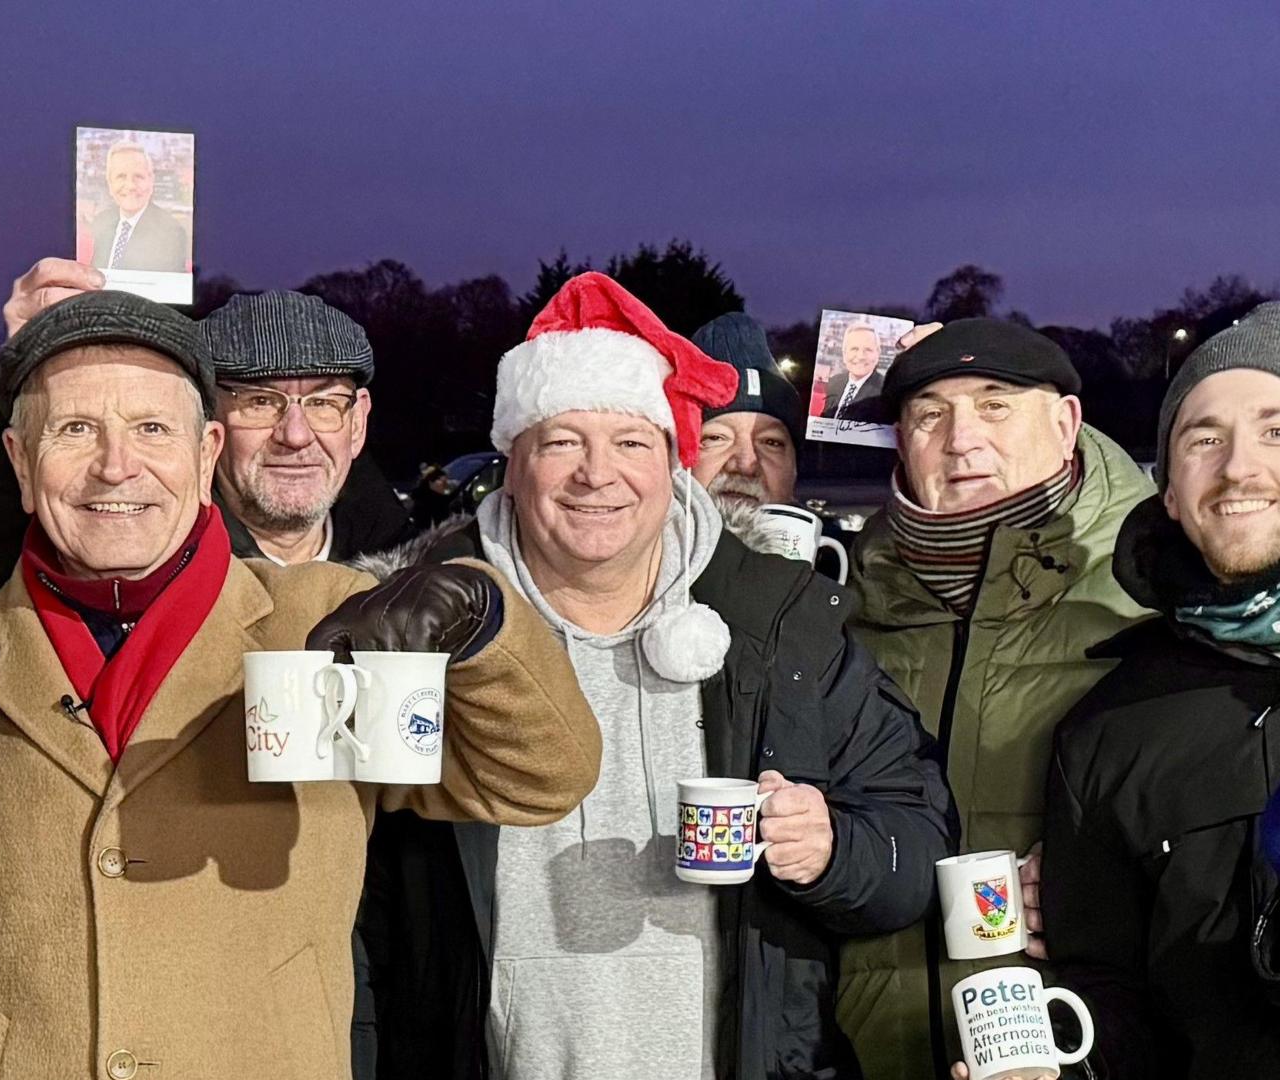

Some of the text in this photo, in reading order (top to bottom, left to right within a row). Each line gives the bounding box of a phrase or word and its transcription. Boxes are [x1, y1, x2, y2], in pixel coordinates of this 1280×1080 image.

[962, 980, 1036, 1015] Peter
[986, 1006, 1008, 1017] best
[969, 1021, 994, 1037] from
[973, 1029, 1047, 1052] Afternoon
[975, 1042, 1050, 1066] WI Ladies
